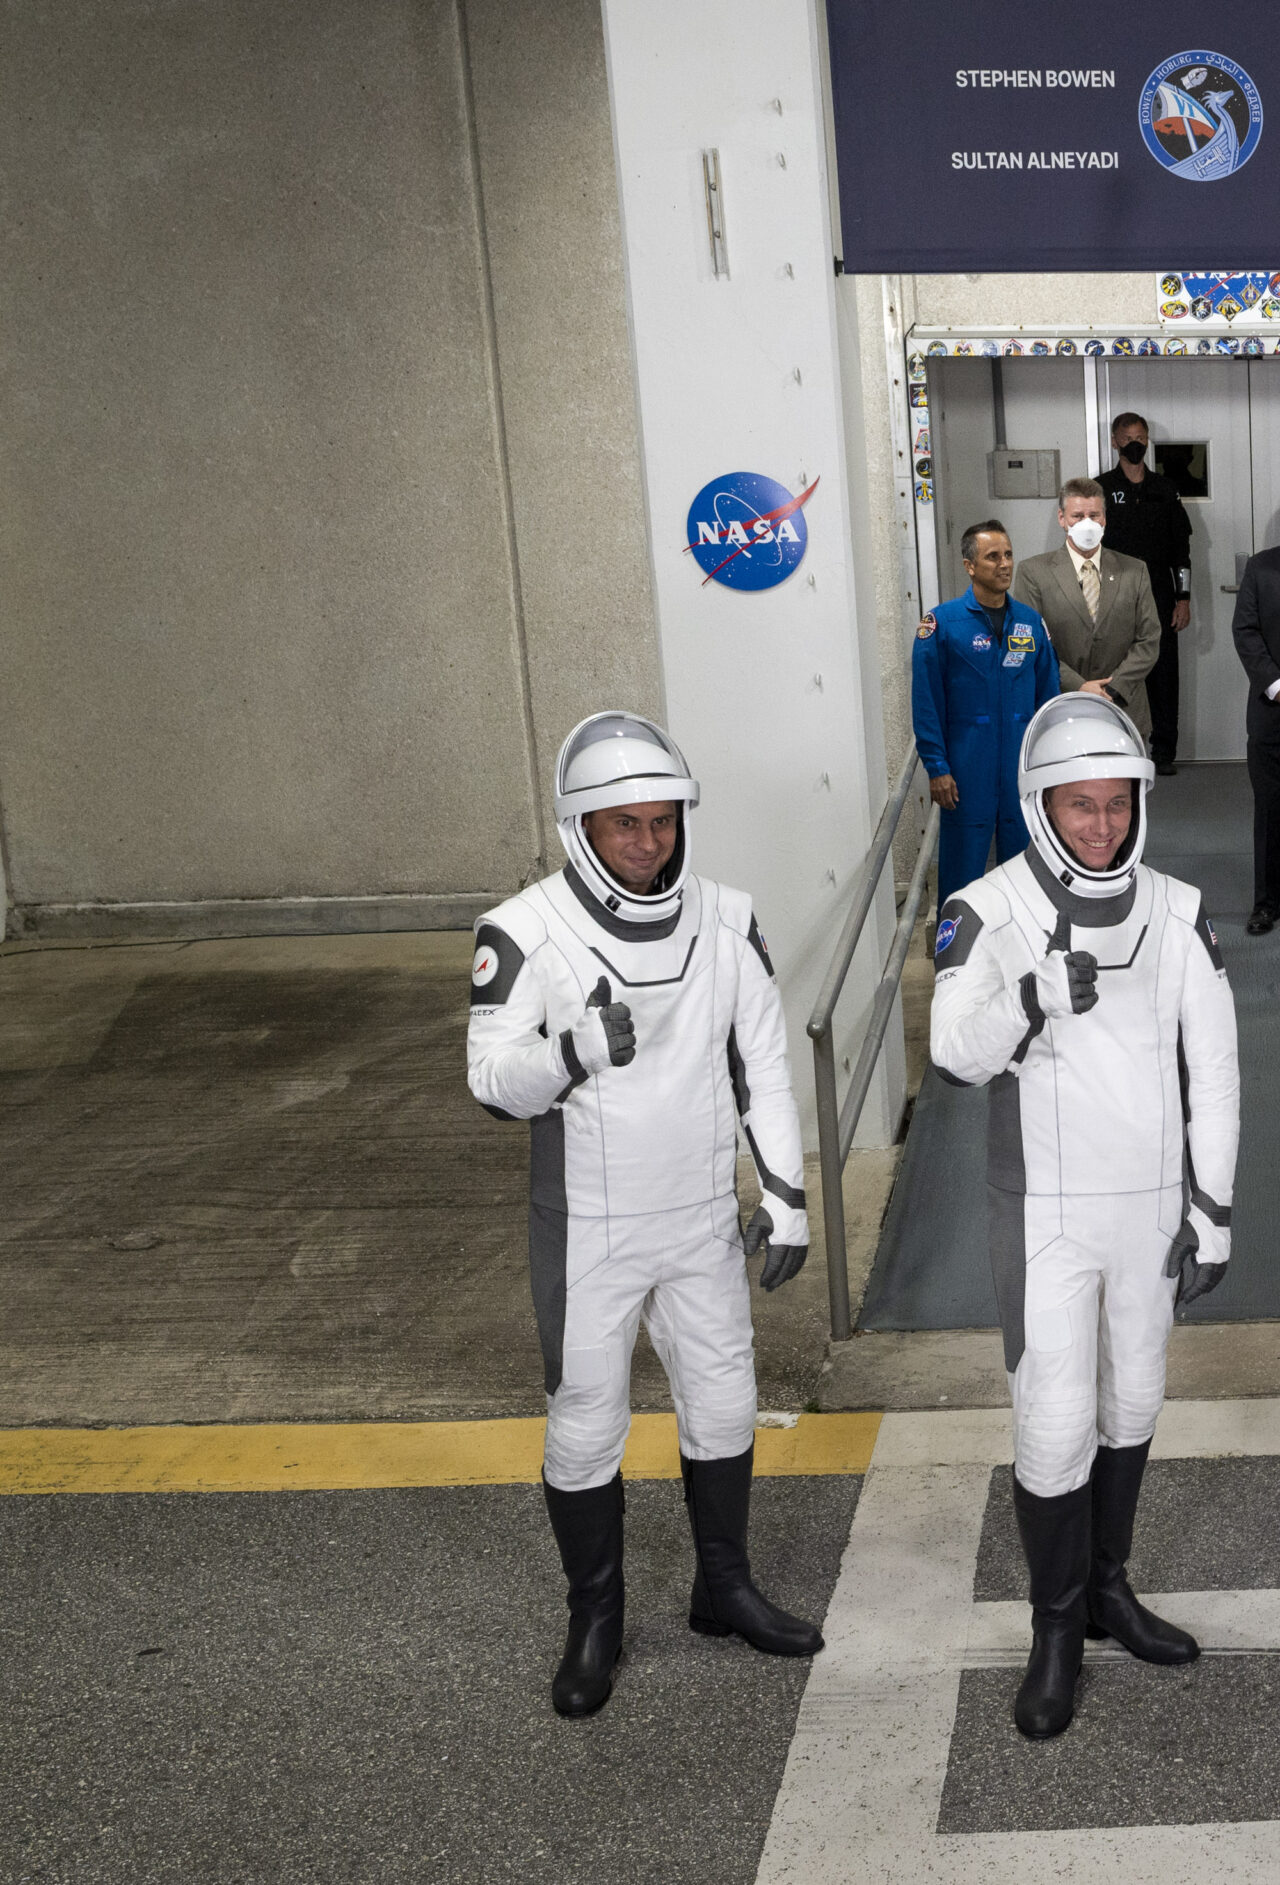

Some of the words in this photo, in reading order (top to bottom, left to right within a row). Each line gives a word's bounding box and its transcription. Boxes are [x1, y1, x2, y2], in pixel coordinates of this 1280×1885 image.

[1155, 54, 1192, 80] HOBURG
[955, 69, 1041, 88] STEPHEN
[1046, 69, 1116, 88] BOWEN
[1141, 88, 1155, 125] BOWEN
[951, 151, 1024, 170] SULTAN
[1027, 151, 1119, 170] ALNEYADI
[1111, 491, 1126, 504] 12
[696, 519, 801, 545] NASA
